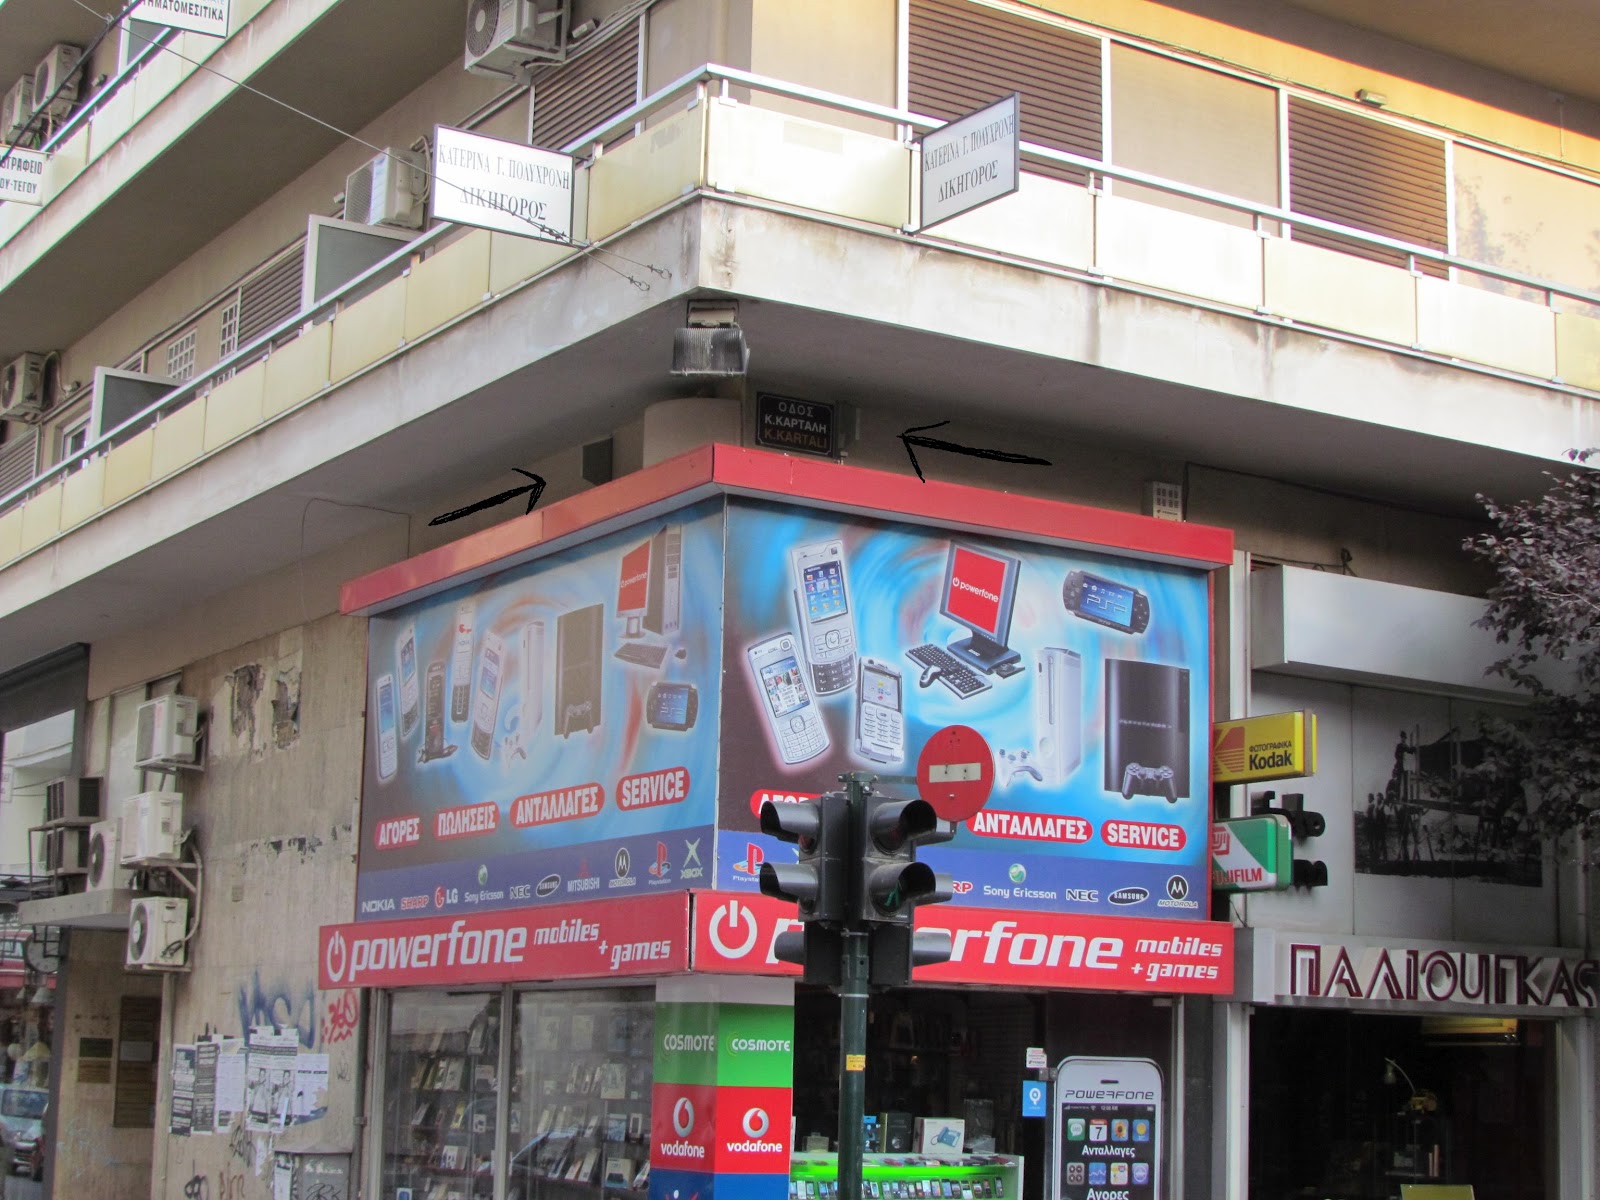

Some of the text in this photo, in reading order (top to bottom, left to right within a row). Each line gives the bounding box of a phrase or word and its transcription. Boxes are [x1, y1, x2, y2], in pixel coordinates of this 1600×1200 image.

[924, 142, 960, 172] ΚΑΤΕΡΙΝΑ
[970, 114, 1015, 151] ΠΟΛΥΧΡΟΝΗ
[438, 144, 490, 173] ΚΑΤΕΡΙΝΑ
[509, 160, 570, 190] ΠΟΛΥΧΡΟΝΗ
[938, 160, 998, 202] ΔΙΚΗΓΟΡΟΣ
[459, 186, 547, 221] ΔΙΚΗΓΟΡΟΣ
[778, 401, 814, 417] ΟΔΟΣ
[764, 414, 827, 434] Κ.ΚΑΡΤΑΛΗ
[960, 581, 999, 603] powerfone
[1249, 750, 1292, 770] Kodak
[621, 771, 685, 807] SERVICE
[515, 786, 599, 825] ΑΝΤΑΛΛΑΓΕΣ
[438, 805, 496, 837] ΠΩΛΗΣΕΙΣ
[973, 812, 1088, 840] ΑΝΤΑΛΛΑΓΕΣ
[378, 818, 420, 846] ΑΓΟΡΕΣ
[1107, 823, 1180, 848] SERVICE
[680, 867, 703, 880] XBOX
[1213, 867, 1263, 885] UJIFILM
[510, 885, 531, 899] NEC
[567, 877, 600, 892] MITSUBISHI
[983, 885, 1010, 899] Sony
[1013, 887, 1057, 899] Ericsson
[400, 895, 430, 910] SHARP
[446, 888, 459, 904] LG
[464, 890, 504, 904] Sony Ericsson
[1066, 889, 1099, 902] NEC
[1113, 891, 1145, 901] SAMSUNG
[361, 899, 396, 913] NOKIA
[1157, 900, 1199, 909] MOTOROLA
[348, 918, 600, 982] powerfone mobiles
[1135, 936, 1223, 957] mobiles
[663, 1034, 715, 1052] COSMOTE
[731, 1038, 791, 1052] COSMOTE
[1095, 1126, 1103, 1139] 7
[661, 1141, 705, 1158] vodafone
[726, 1140, 783, 1152] vodafone
[1082, 1144, 1136, 1158] Ανταλλαγες
